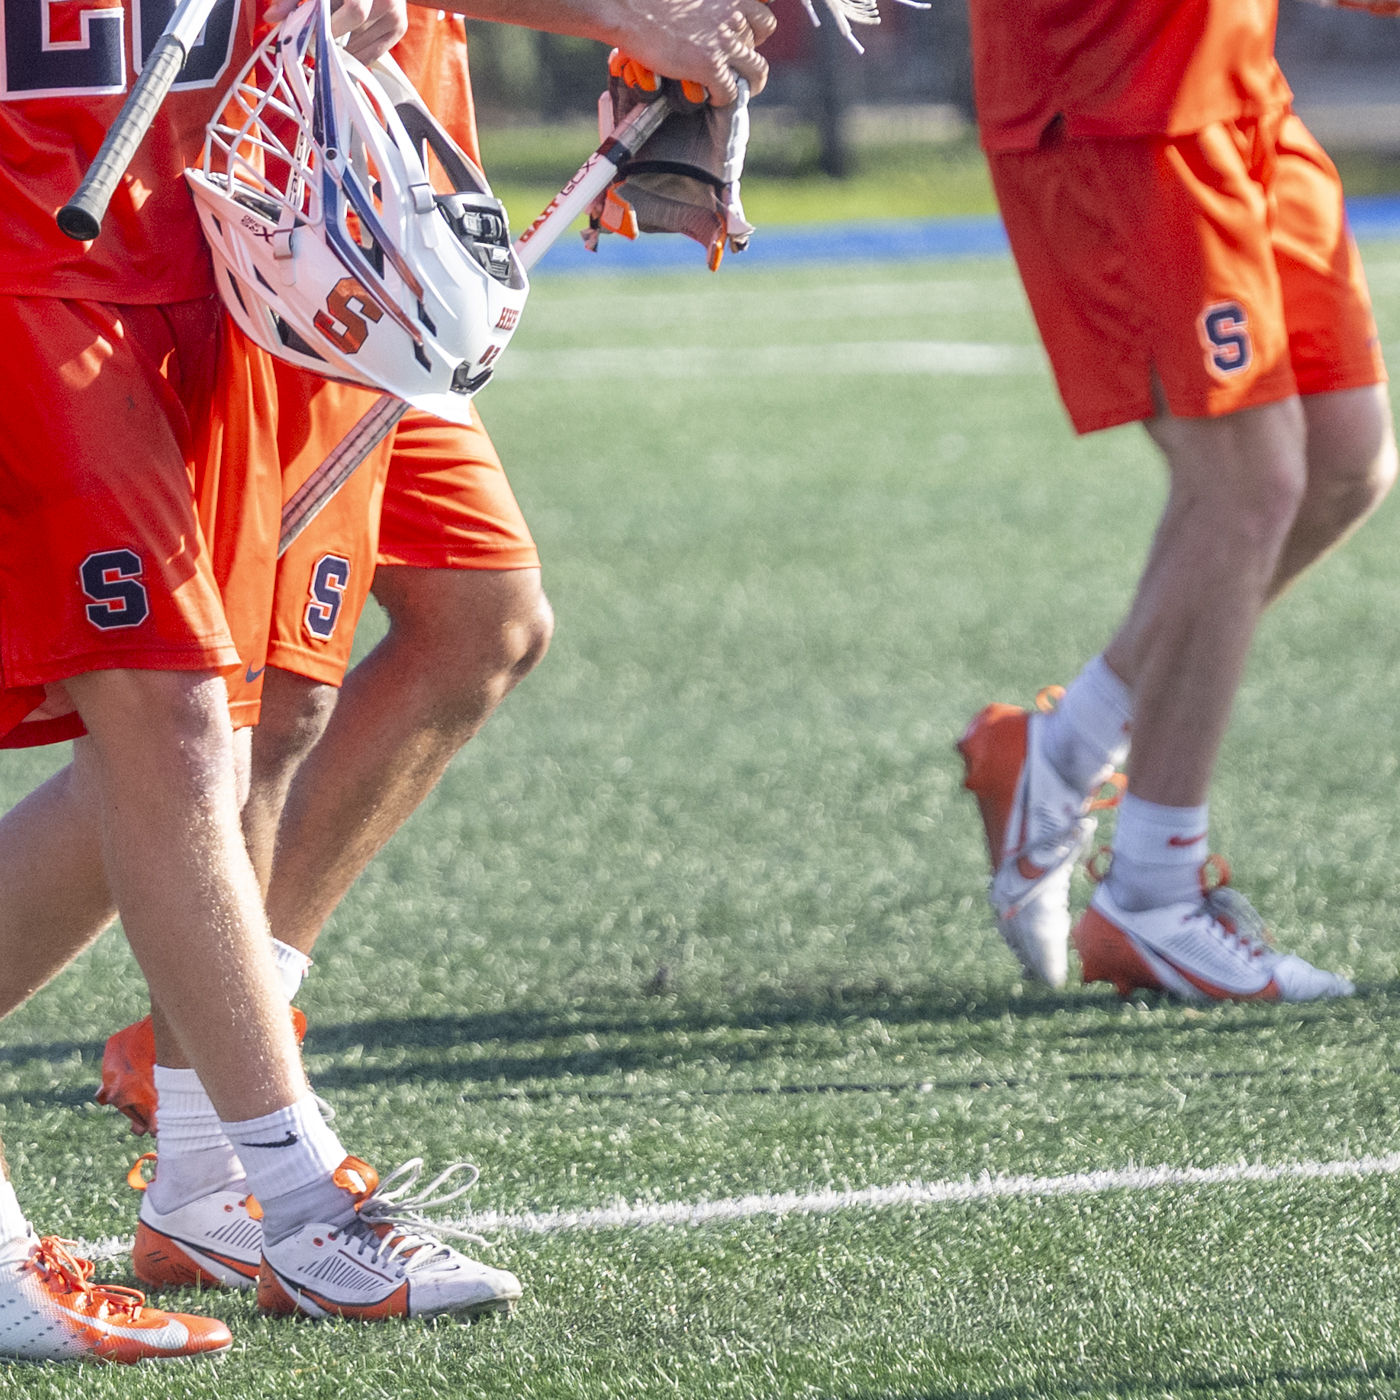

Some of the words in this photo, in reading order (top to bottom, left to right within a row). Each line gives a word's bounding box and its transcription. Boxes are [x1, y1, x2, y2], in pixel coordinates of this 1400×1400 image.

[312, 276, 384, 355] S
[1202, 300, 1253, 377] S
[79, 547, 150, 632] S
[304, 552, 352, 642] S
